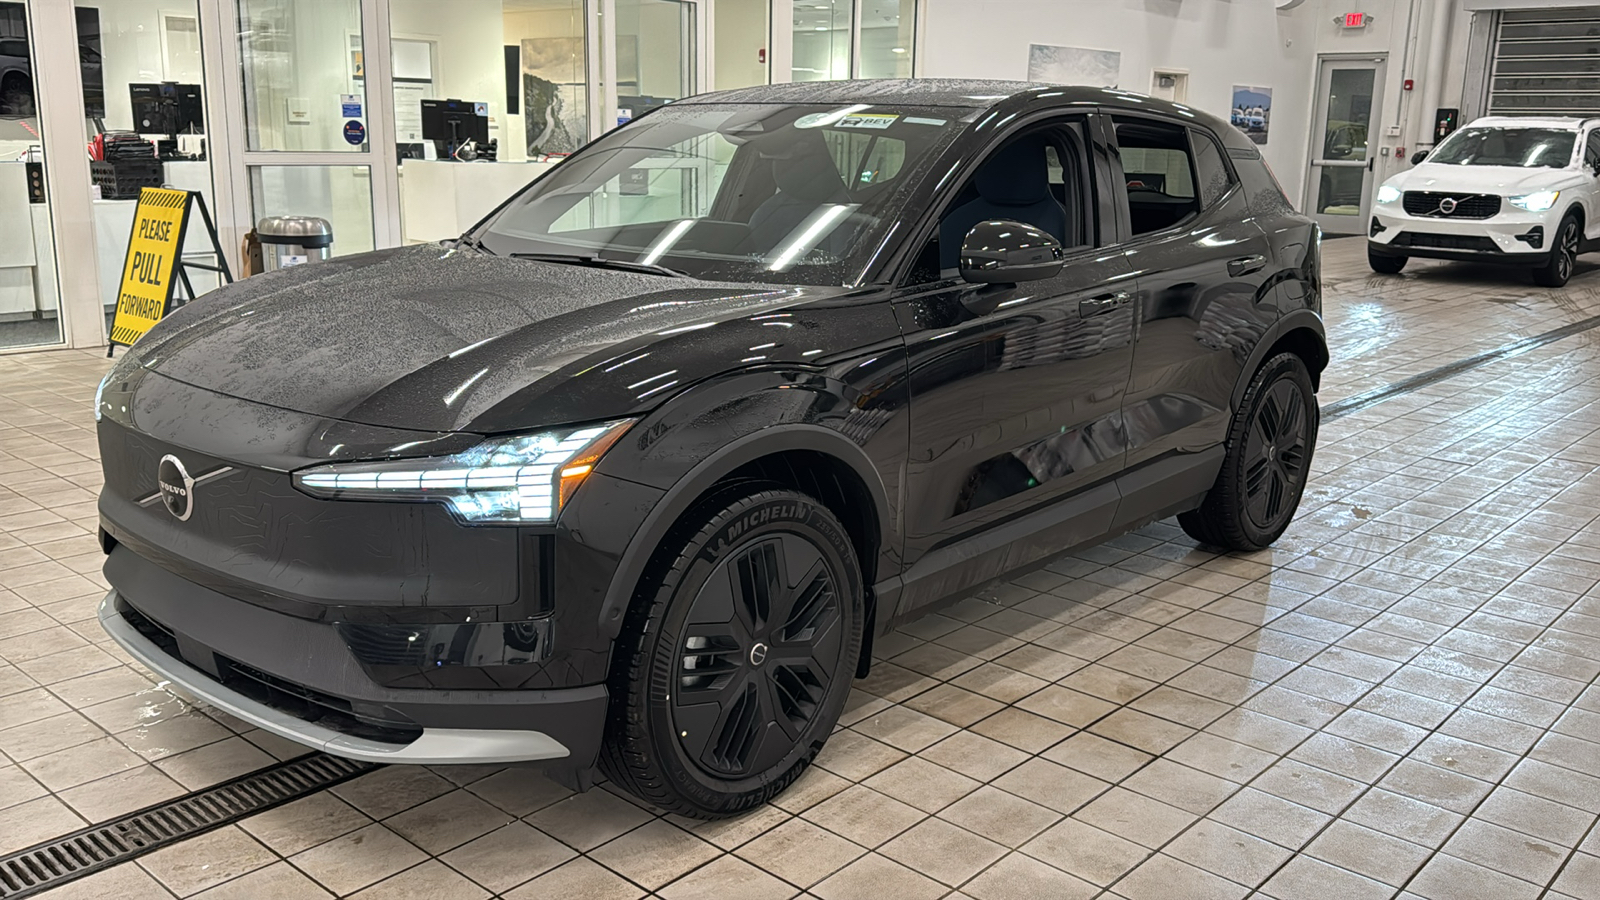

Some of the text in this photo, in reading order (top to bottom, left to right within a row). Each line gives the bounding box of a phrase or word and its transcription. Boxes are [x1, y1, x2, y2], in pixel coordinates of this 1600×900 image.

[1346, 13, 1363, 27] EXIT
[138, 218, 173, 242] PLEASE
[129, 251, 162, 286] PULL
[119, 293, 162, 321] FORWARD
[160, 481, 186, 496] VOLVO
[727, 504, 806, 542] MICHELIN
